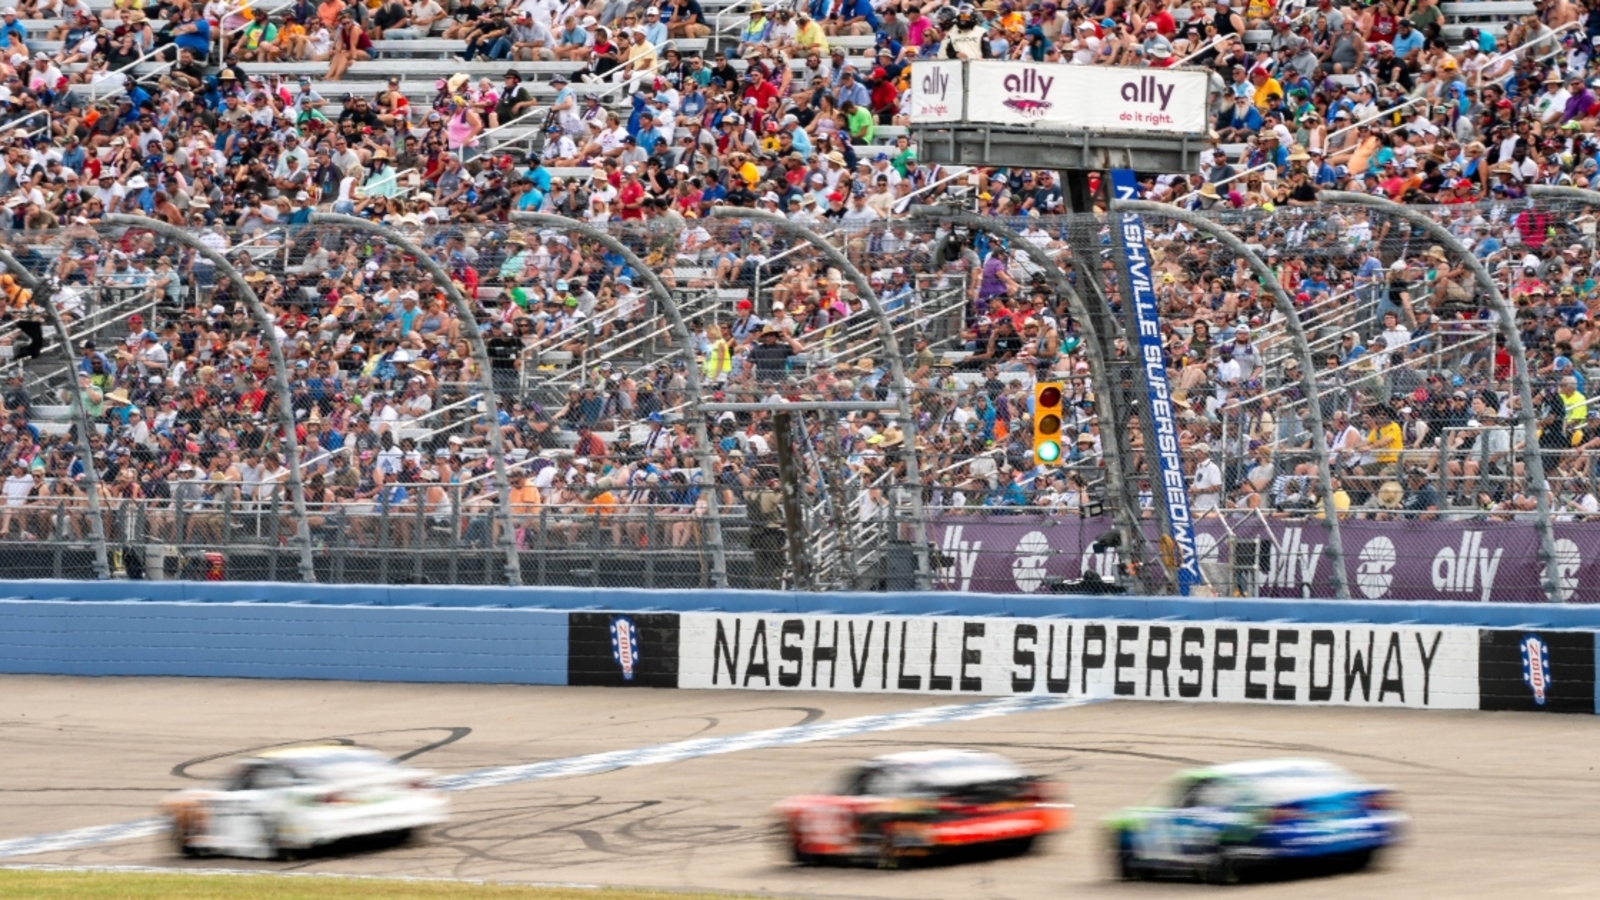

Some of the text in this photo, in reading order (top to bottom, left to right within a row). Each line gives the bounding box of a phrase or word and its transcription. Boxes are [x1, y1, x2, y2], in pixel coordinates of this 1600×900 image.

[923, 66, 949, 101] ally
[1004, 68, 1054, 100] ally
[1121, 75, 1175, 111] ally
[1120, 111, 1174, 126] do it right.
[1143, 343, 1198, 577] SUPERSPEEDWAY
[931, 525, 982, 591] lly
[1431, 530, 1503, 602] ally
[712, 618, 1442, 705] NASHVILLE SUPERSPEEDWAY
